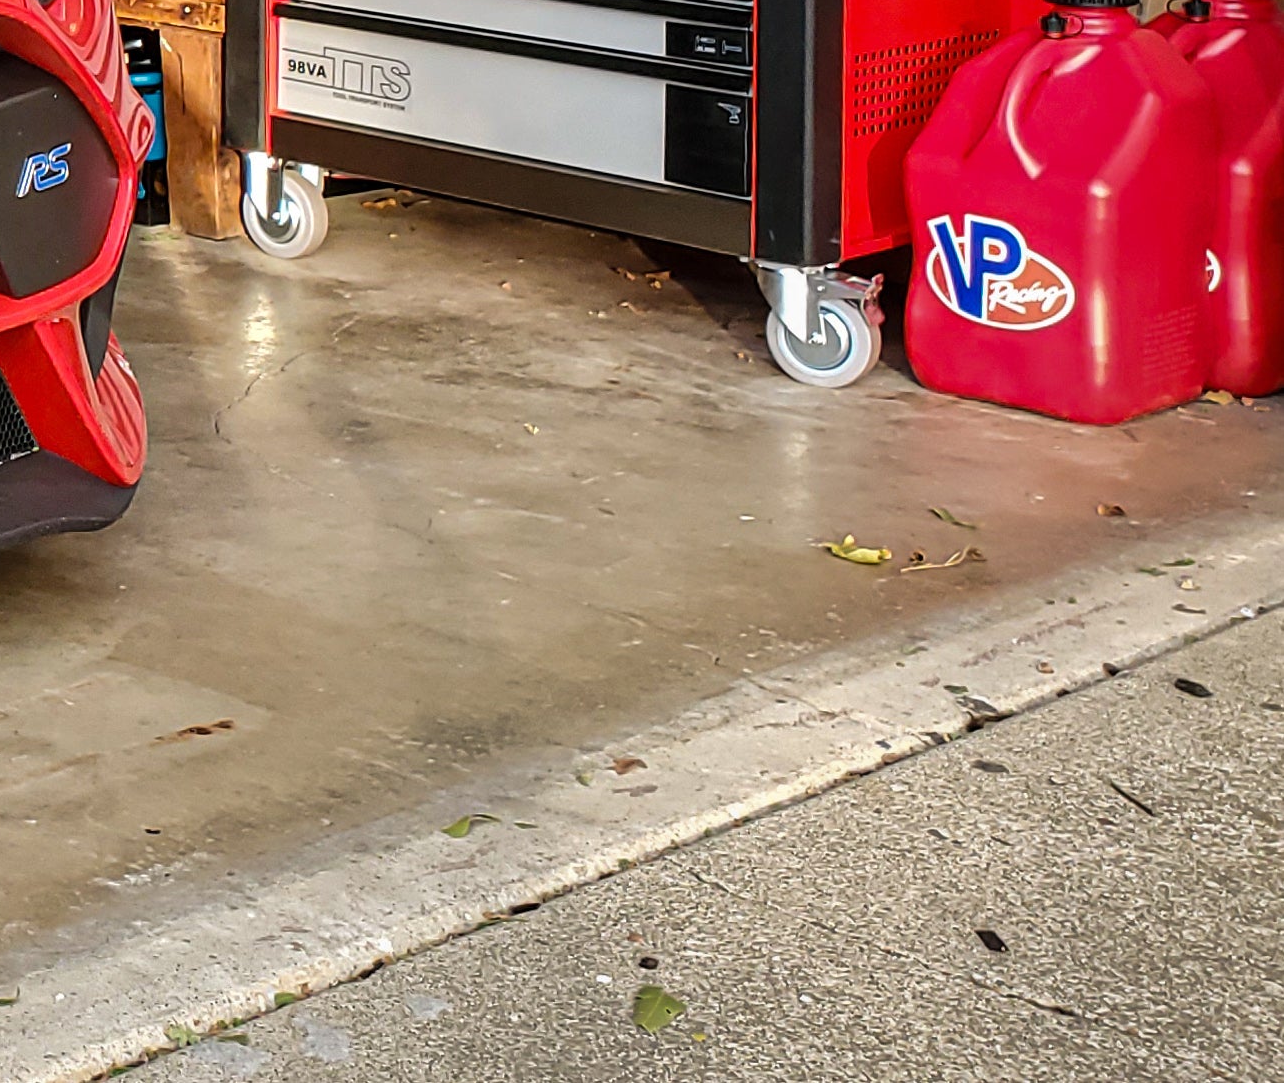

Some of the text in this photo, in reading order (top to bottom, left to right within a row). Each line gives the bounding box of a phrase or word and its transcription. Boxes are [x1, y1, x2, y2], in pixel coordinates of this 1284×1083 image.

[288, 46, 412, 102] 98VA TTS
[16, 143, 72, 198] RS
[928, 214, 1027, 321] VP
[988, 280, 1067, 315] Racing
